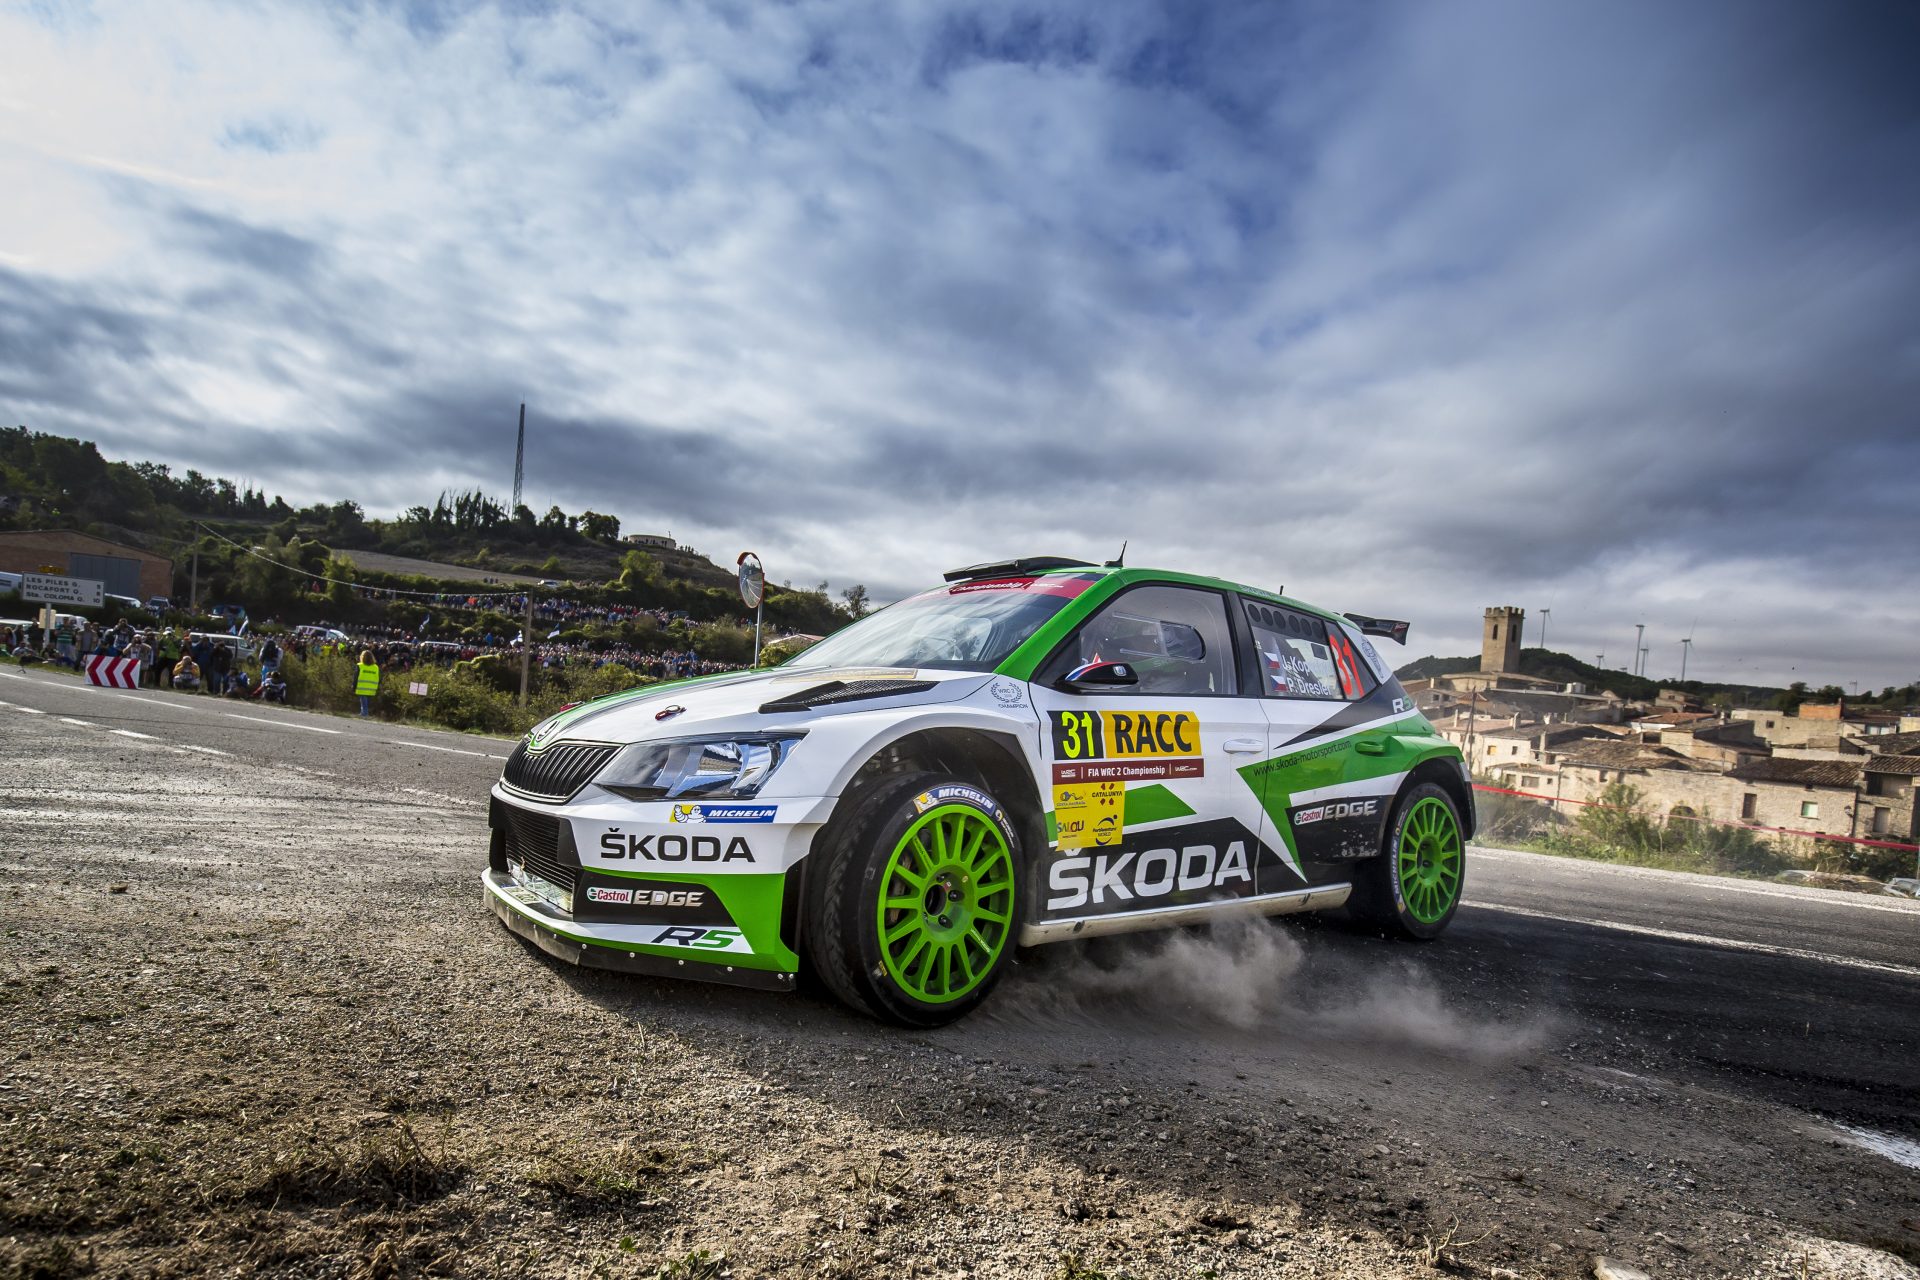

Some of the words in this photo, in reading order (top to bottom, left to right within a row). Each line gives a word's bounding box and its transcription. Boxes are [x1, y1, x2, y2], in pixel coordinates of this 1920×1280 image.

[26, 576, 42, 584] LES
[45, 578, 69, 587] PILES
[26, 584, 70, 594] ROCAFORT
[44, 593, 74, 601] COLOMA
[1330, 634, 1365, 698] 31
[1392, 696, 1412, 713] R5
[1061, 711, 1095, 759] 31
[1111, 714, 1193, 754] RACC
[1253, 740, 1352, 776] www.skoda-motorsport.com
[1088, 768, 1099, 777] FIA
[1100, 767, 1115, 777] WRC
[1116, 767, 1122, 776] 2
[1123, 765, 1166, 776] Championship
[938, 787, 994, 809] MICHELIN
[1091, 790, 1123, 798] CATALUNYA
[708, 809, 776, 818] MICHELIN
[1301, 809, 1322, 823] Castrol
[1323, 800, 1378, 820] EDGE
[1057, 820, 1085, 833] SALOU
[600, 827, 756, 863] ŠKODA
[1047, 841, 1252, 911] ŠKODA
[597, 889, 630, 902] Castrol
[633, 889, 705, 907] EDGE
[650, 927, 743, 949] R5
